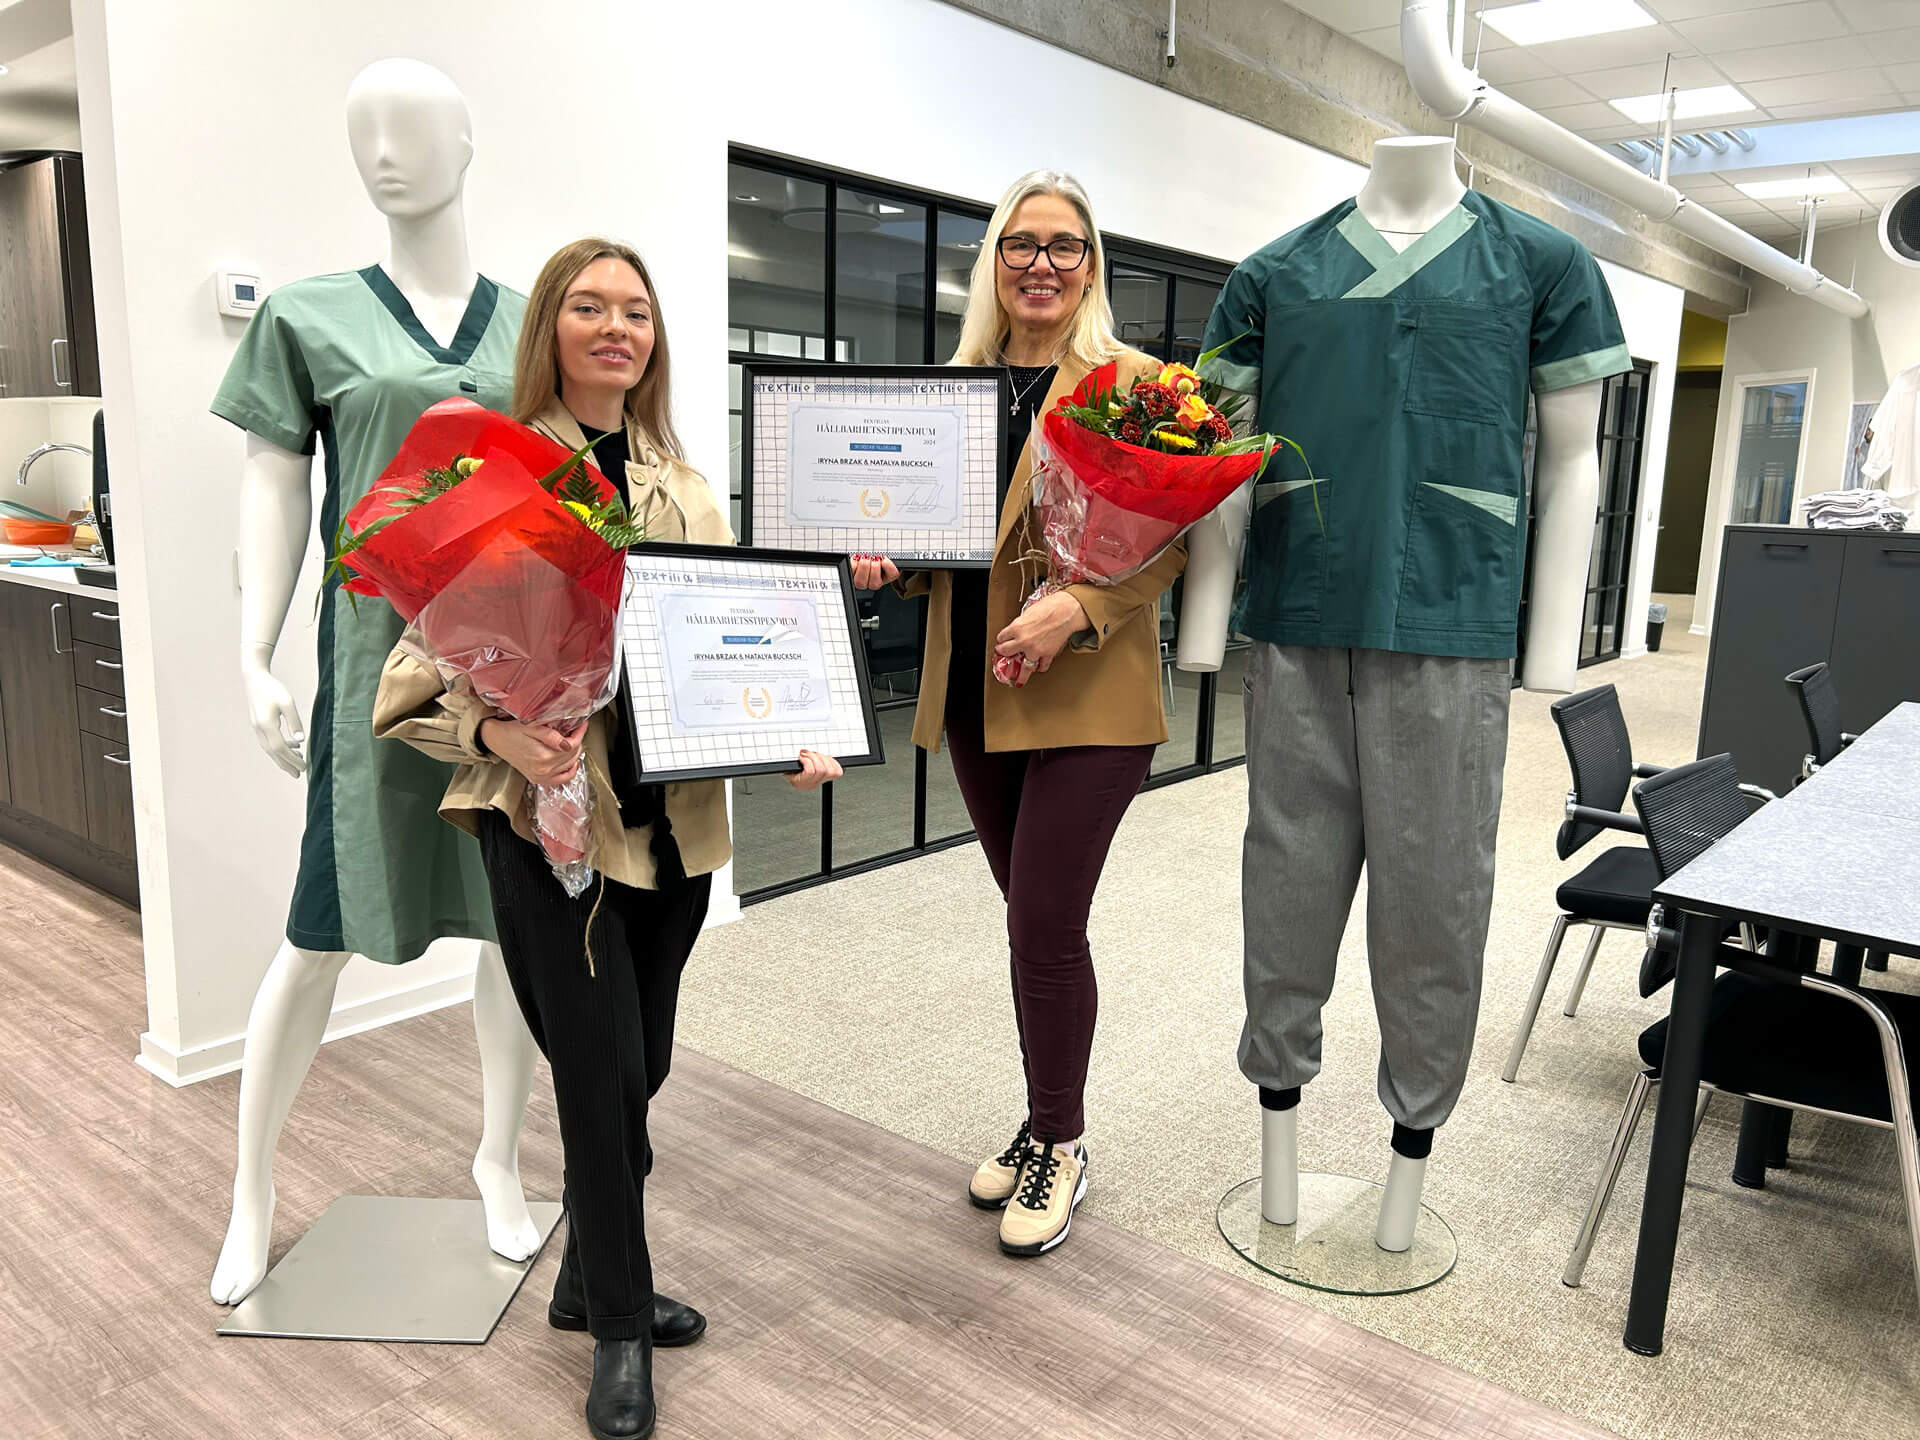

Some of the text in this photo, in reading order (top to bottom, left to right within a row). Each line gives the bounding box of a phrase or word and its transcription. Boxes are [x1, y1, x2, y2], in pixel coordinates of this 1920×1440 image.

[816, 422, 936, 436] HÅLLBARHETSSTIPENDIUM
[817, 457, 839, 465] IRYNA
[840, 458, 863, 466] BRZAK
[870, 459, 900, 467] NATALYA
[901, 460, 933, 468] BUCKSCH
